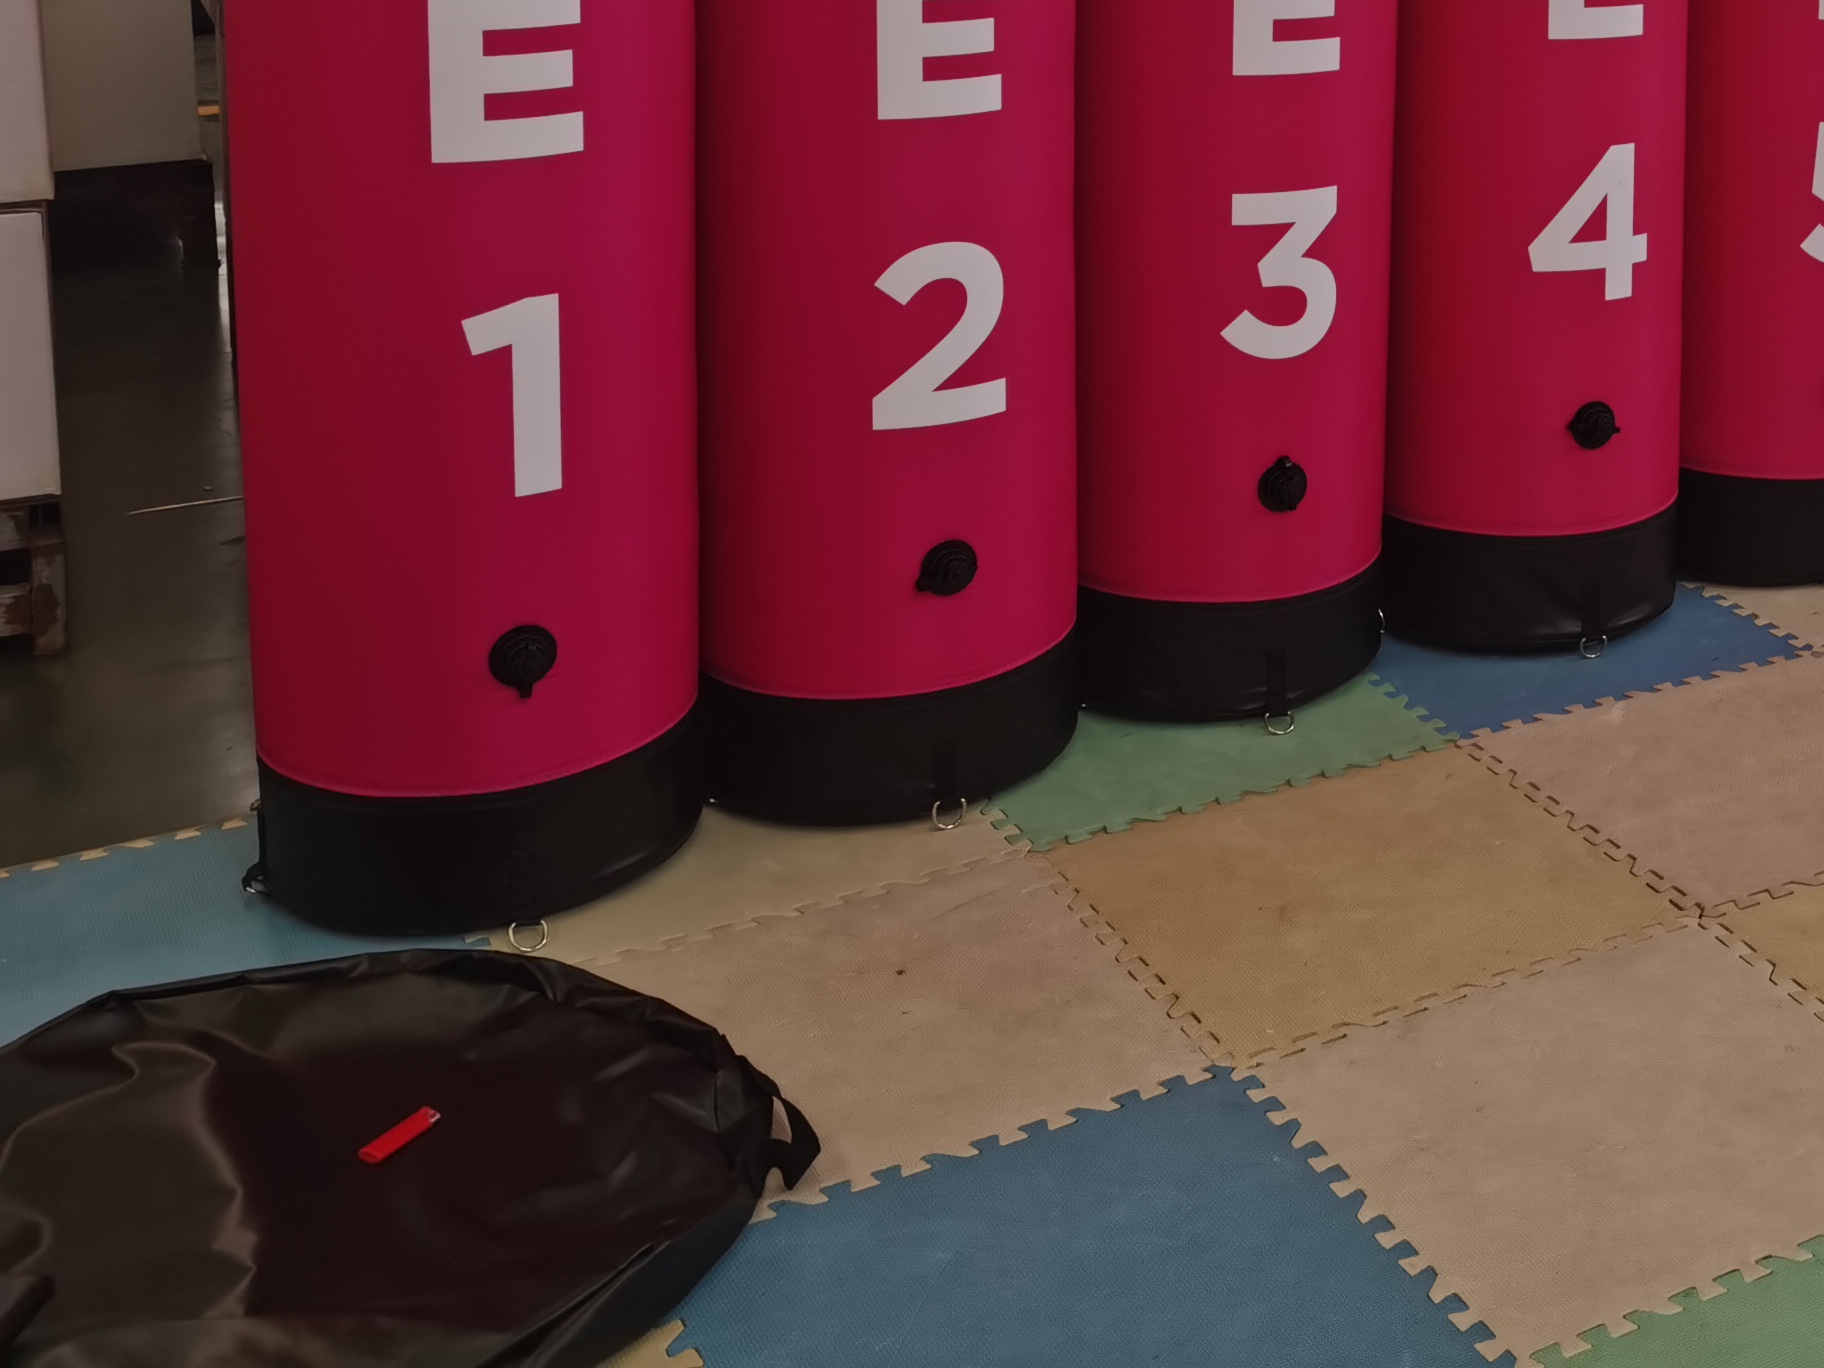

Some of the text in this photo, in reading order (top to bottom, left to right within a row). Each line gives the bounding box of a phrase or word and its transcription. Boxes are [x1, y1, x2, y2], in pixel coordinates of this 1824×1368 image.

[1221, 186, 1337, 359] 3
[1529, 144, 1647, 300] 4
[462, 294, 562, 497] 1
[873, 242, 1006, 430] 2
